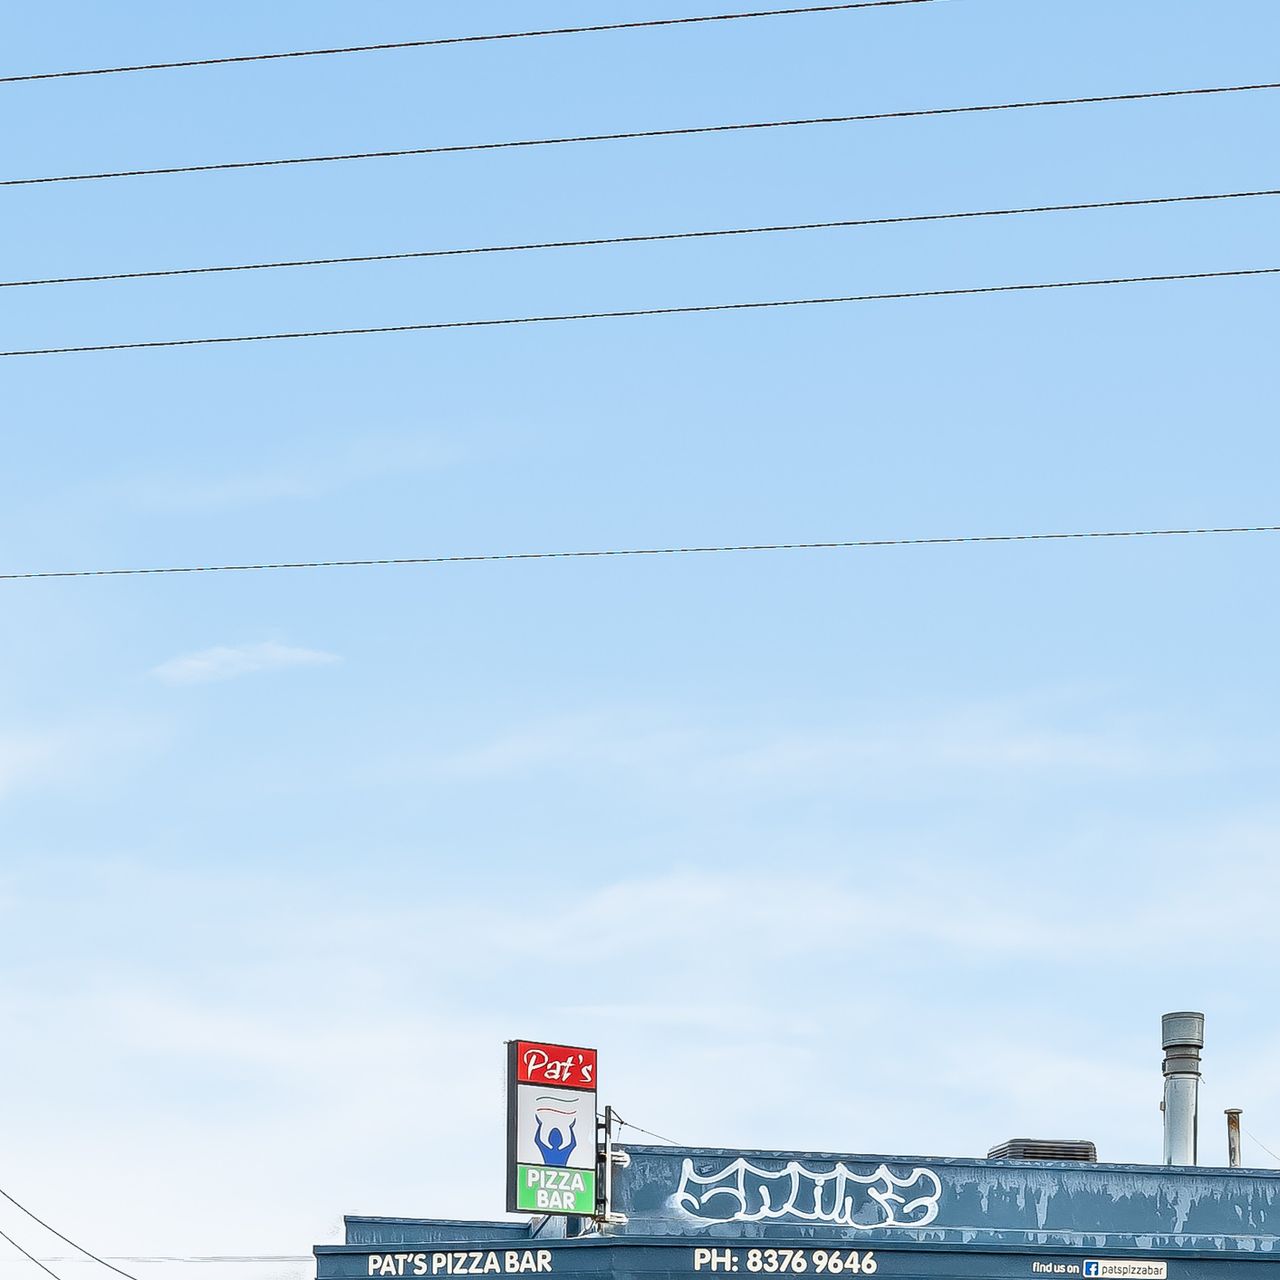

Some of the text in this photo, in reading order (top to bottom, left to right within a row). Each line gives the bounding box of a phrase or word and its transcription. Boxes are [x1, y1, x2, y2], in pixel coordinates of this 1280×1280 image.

[523, 1049, 593, 1083] Pat's
[527, 1169, 585, 1192] PIZZA
[537, 1189, 575, 1210] BAR
[368, 1250, 552, 1276] PAT'S PIZZA BAR
[694, 1248, 878, 1274] PH: 8376 9646
[1032, 1261, 1080, 1274] find us on
[1101, 1264, 1163, 1276] patspizzabar
